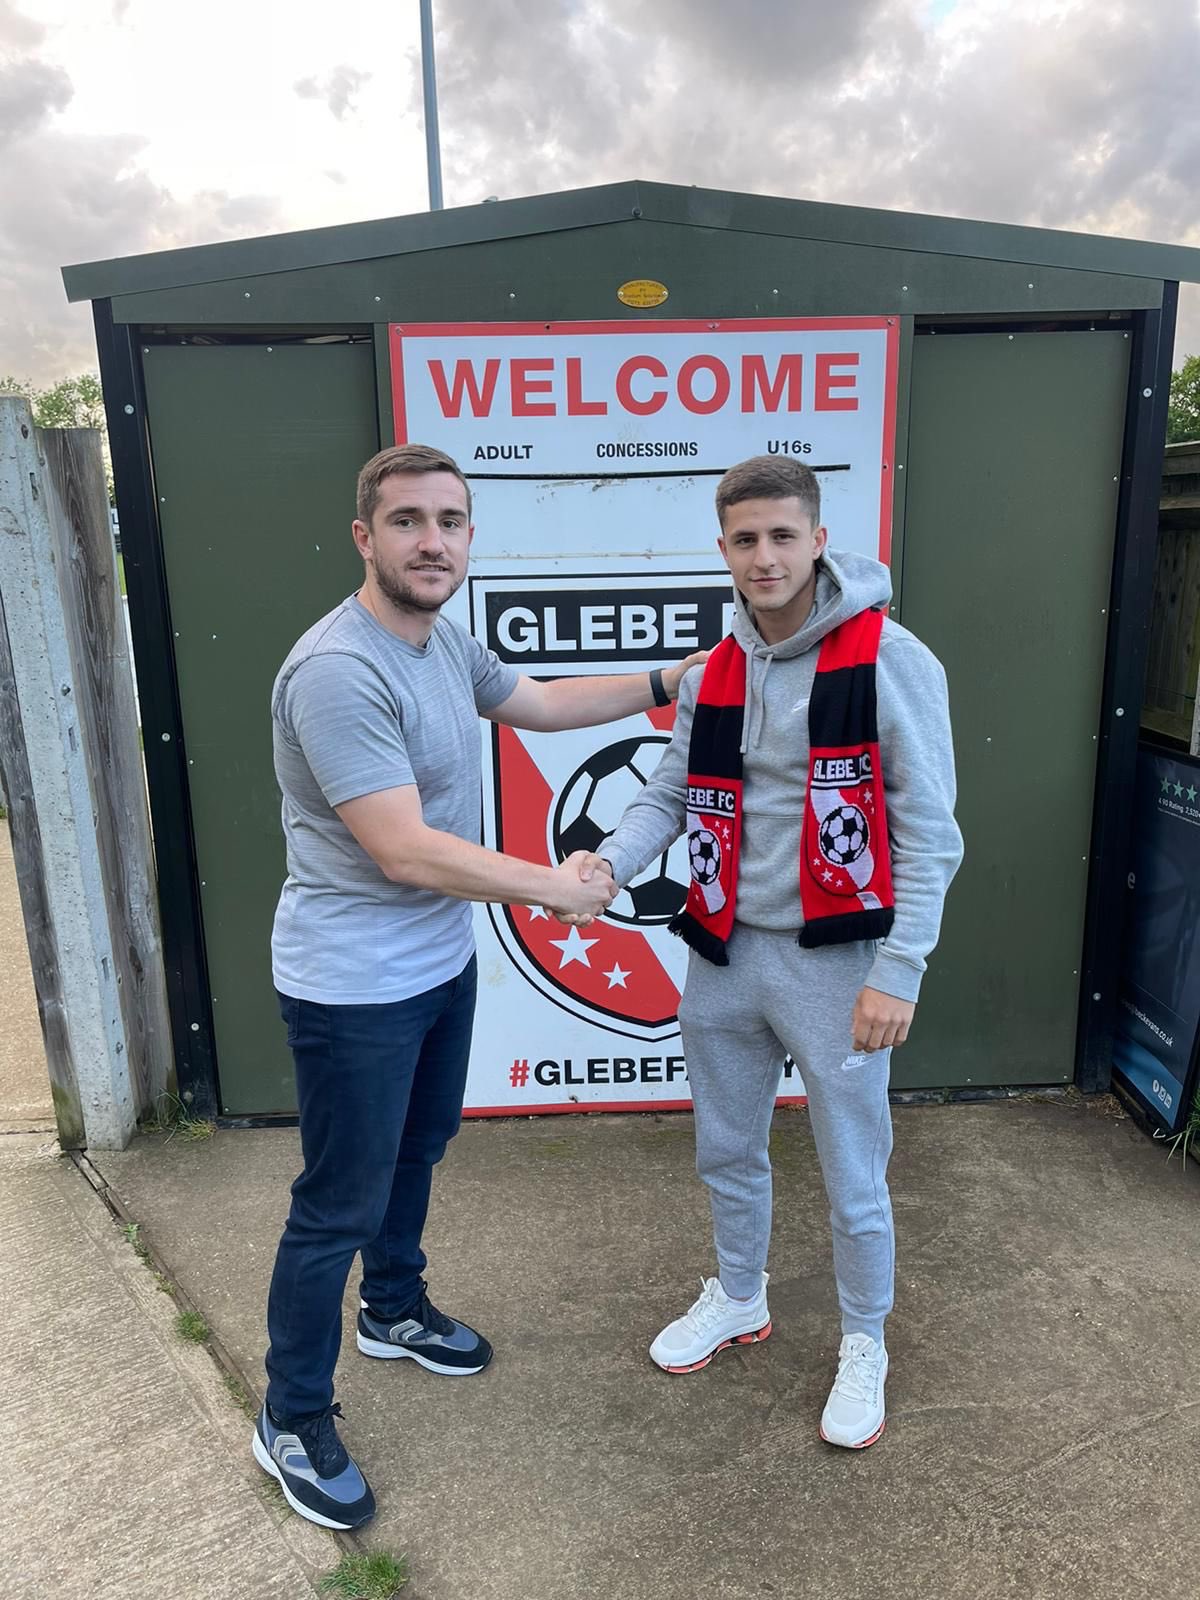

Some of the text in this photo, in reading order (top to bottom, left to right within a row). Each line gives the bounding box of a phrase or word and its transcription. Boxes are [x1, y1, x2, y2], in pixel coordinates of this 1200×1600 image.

[428, 352, 859, 418] WELCOME
[474, 440, 812, 460] ADULT CONCESSIONS U16s
[496, 603, 699, 653] GLEBE
[688, 787, 734, 810] EBE FC
